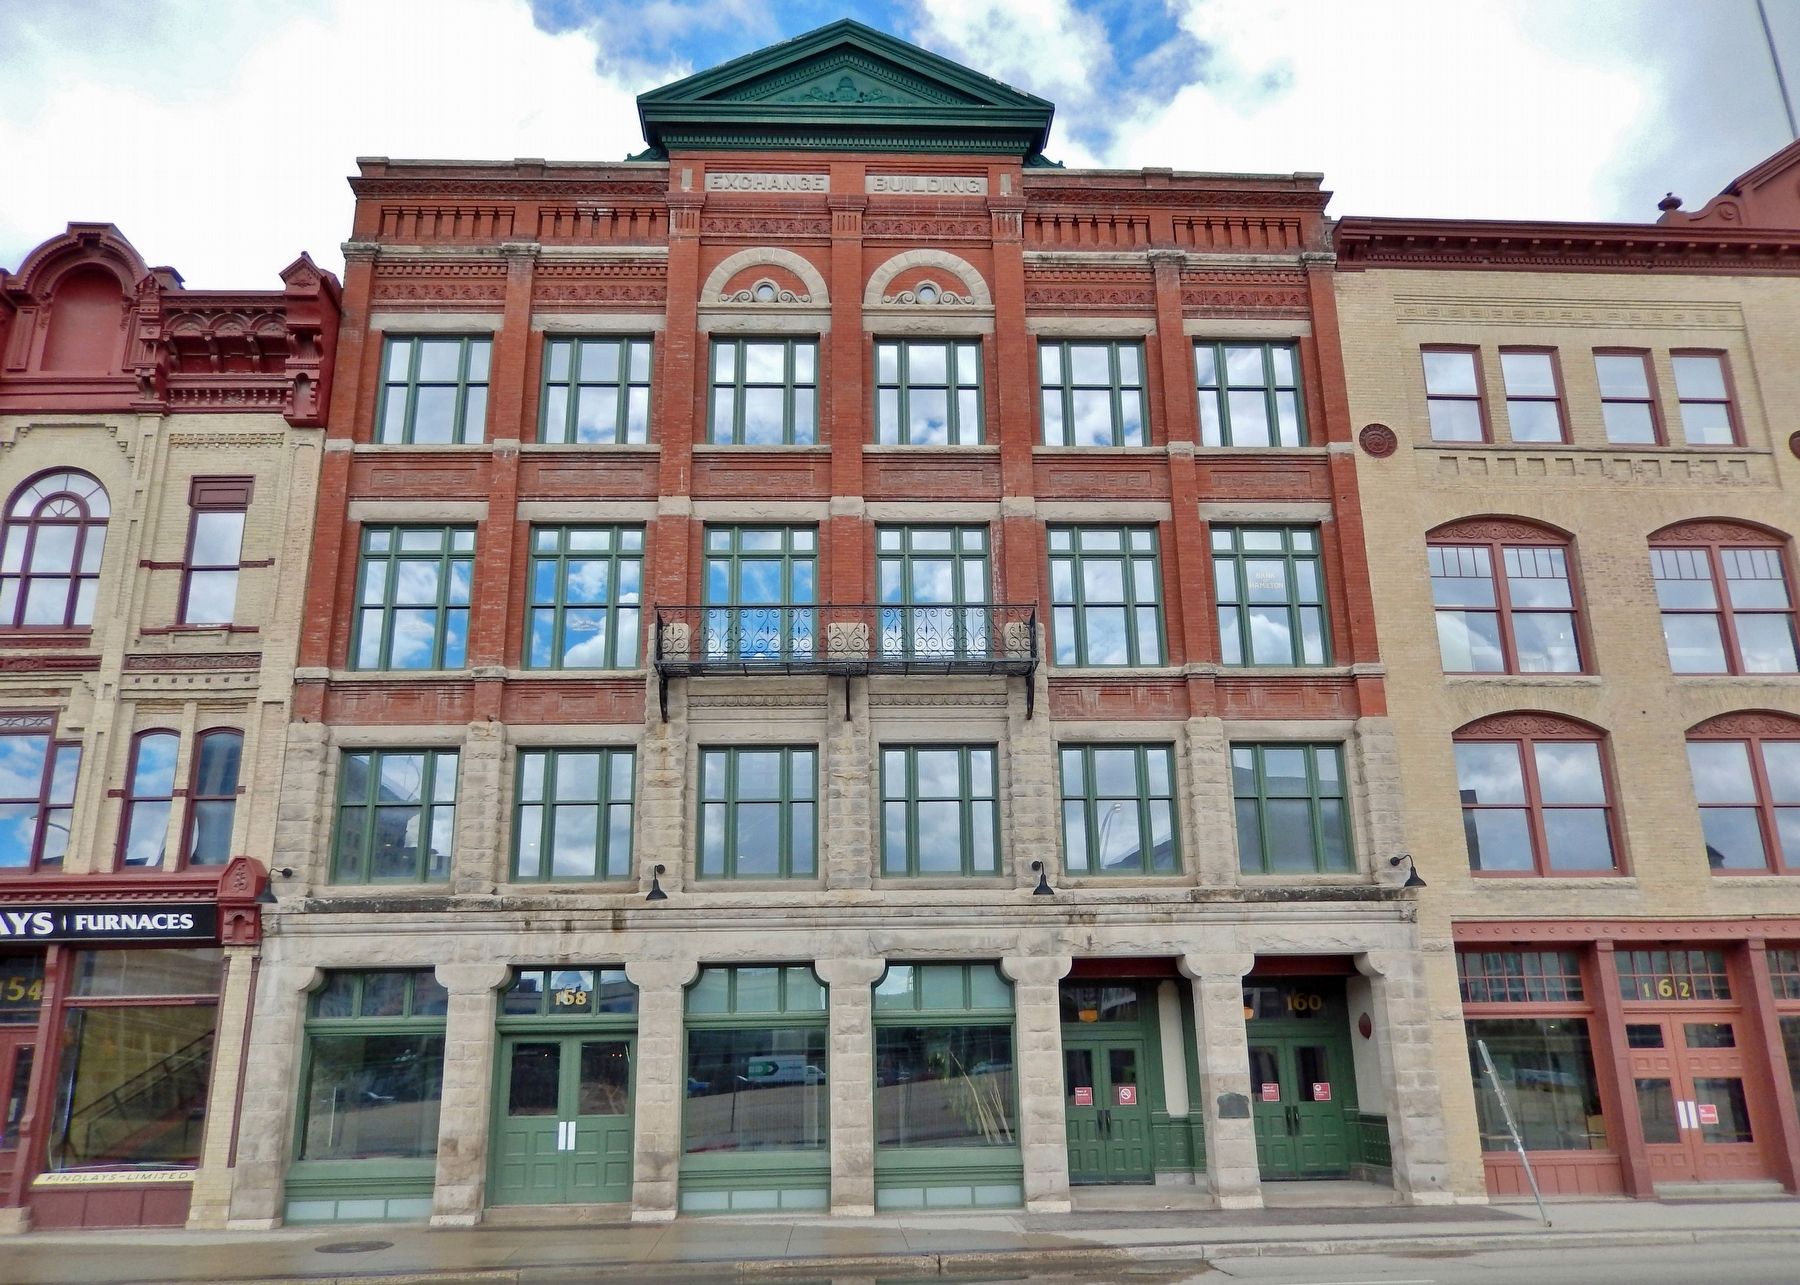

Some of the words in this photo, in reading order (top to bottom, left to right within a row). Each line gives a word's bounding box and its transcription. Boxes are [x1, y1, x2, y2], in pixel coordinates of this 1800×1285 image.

[710, 175, 824, 191] EXCHANGE
[873, 177, 981, 193] BUILDING
[75, 914, 194, 931] FURNACES
[1643, 979, 1690, 997] 162
[1287, 992, 1322, 1010] 160
